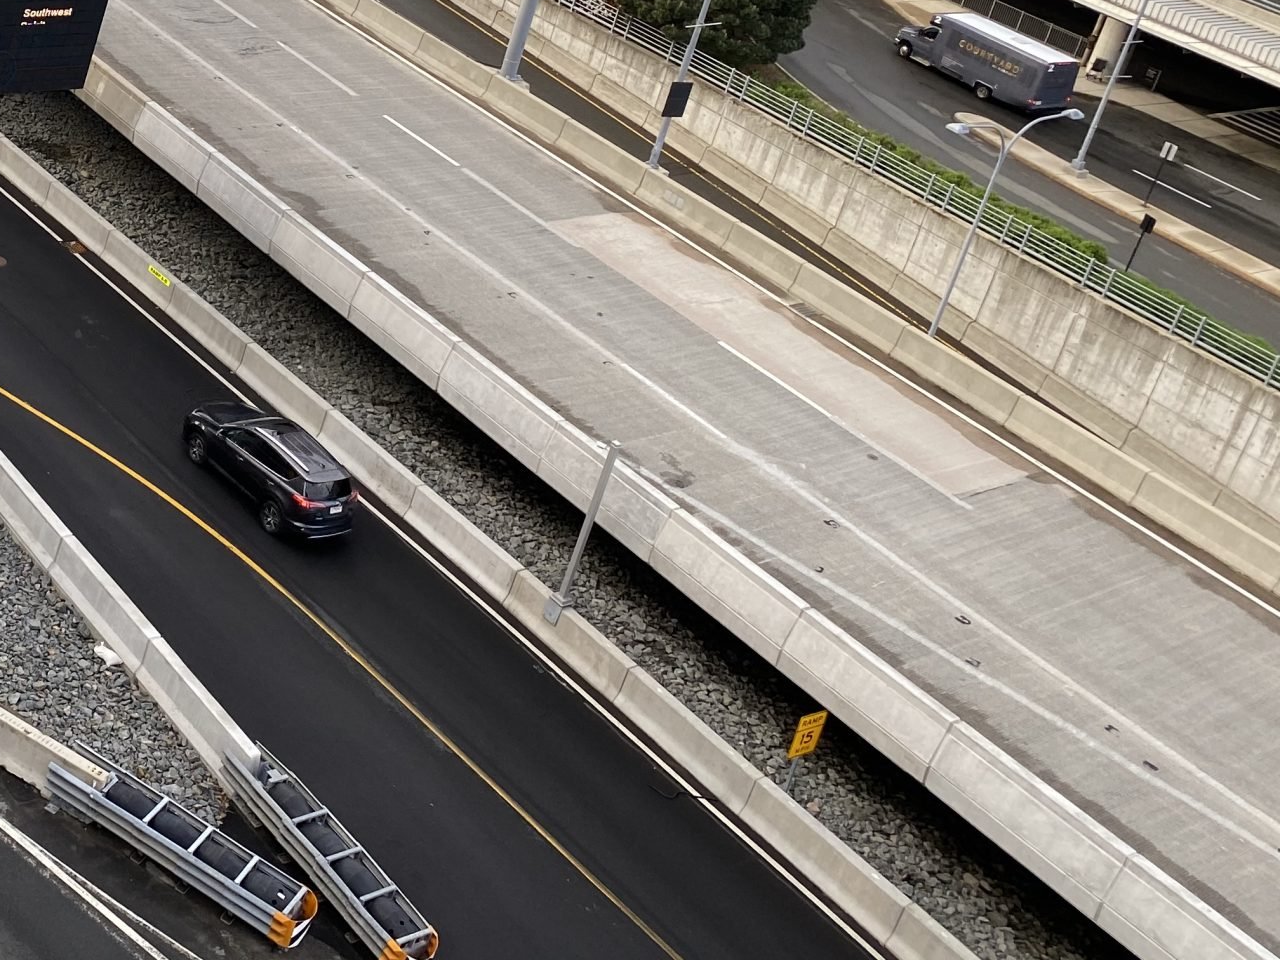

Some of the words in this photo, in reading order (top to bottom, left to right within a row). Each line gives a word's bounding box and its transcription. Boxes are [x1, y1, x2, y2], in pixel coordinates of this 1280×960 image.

[23, 7, 73, 18] Southwest
[934, 15, 942, 24] 2
[1047, 64, 1055, 73] 2
[802, 715, 824, 727] RAMP
[800, 730, 815, 745] 15
